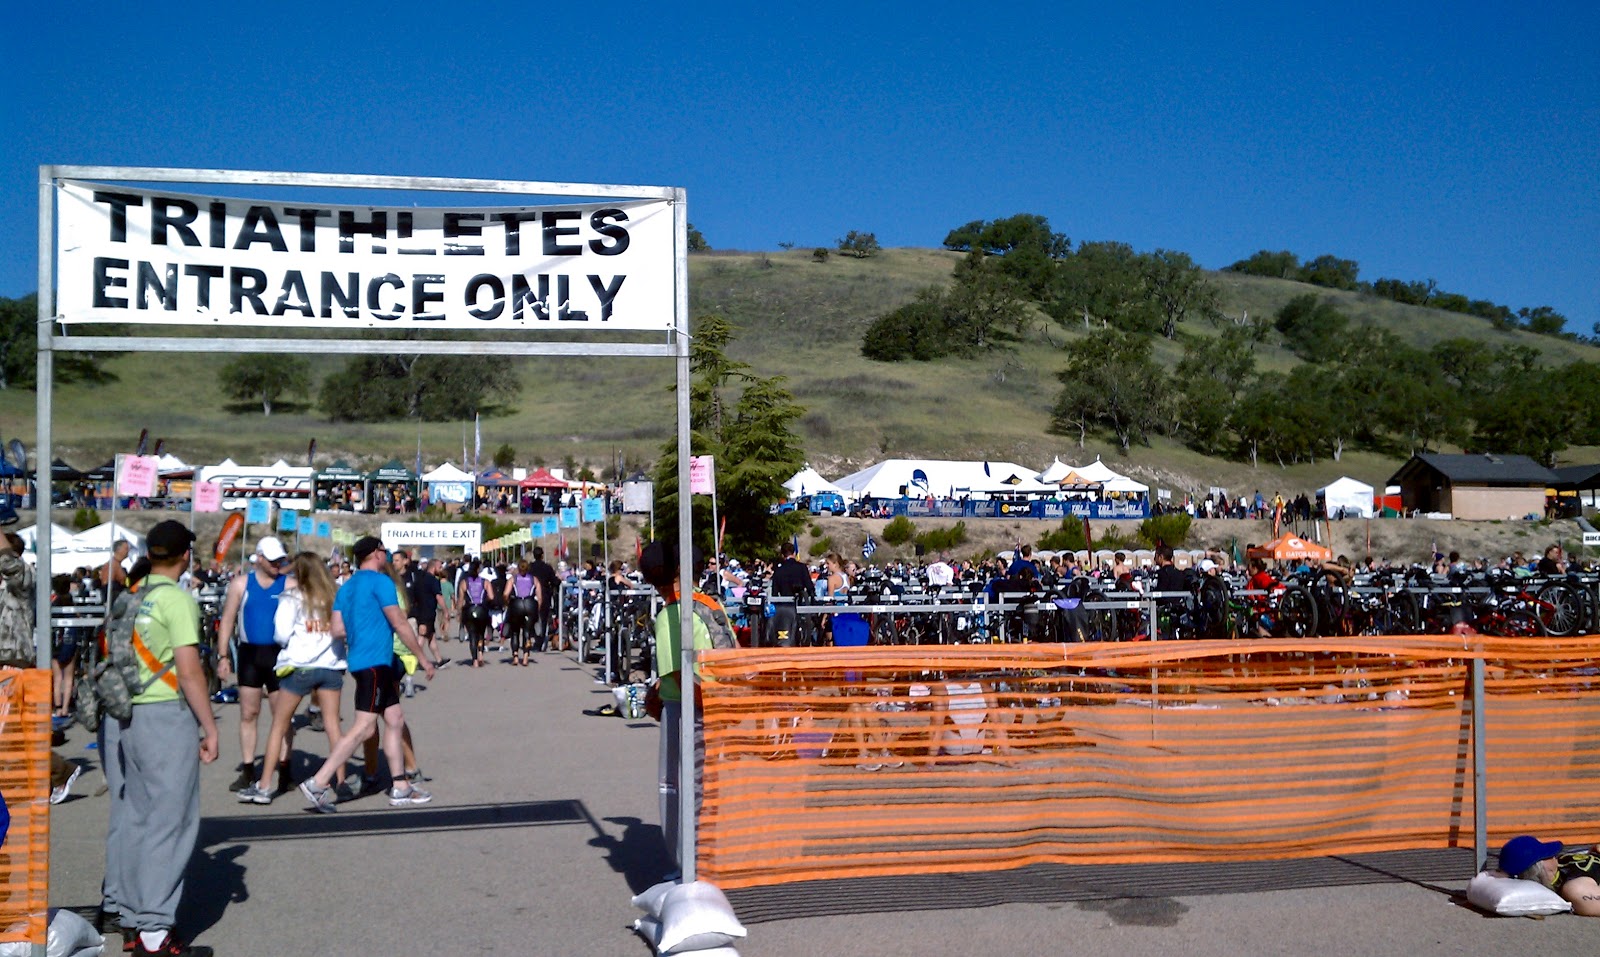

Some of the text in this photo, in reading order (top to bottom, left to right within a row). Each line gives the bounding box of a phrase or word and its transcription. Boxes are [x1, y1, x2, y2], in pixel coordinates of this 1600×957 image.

[93, 190, 631, 256] TRIATHLETES
[92, 256, 627, 322] ENTRANCE ONLY
[388, 530, 477, 538] TRIATHLETE EXIT
